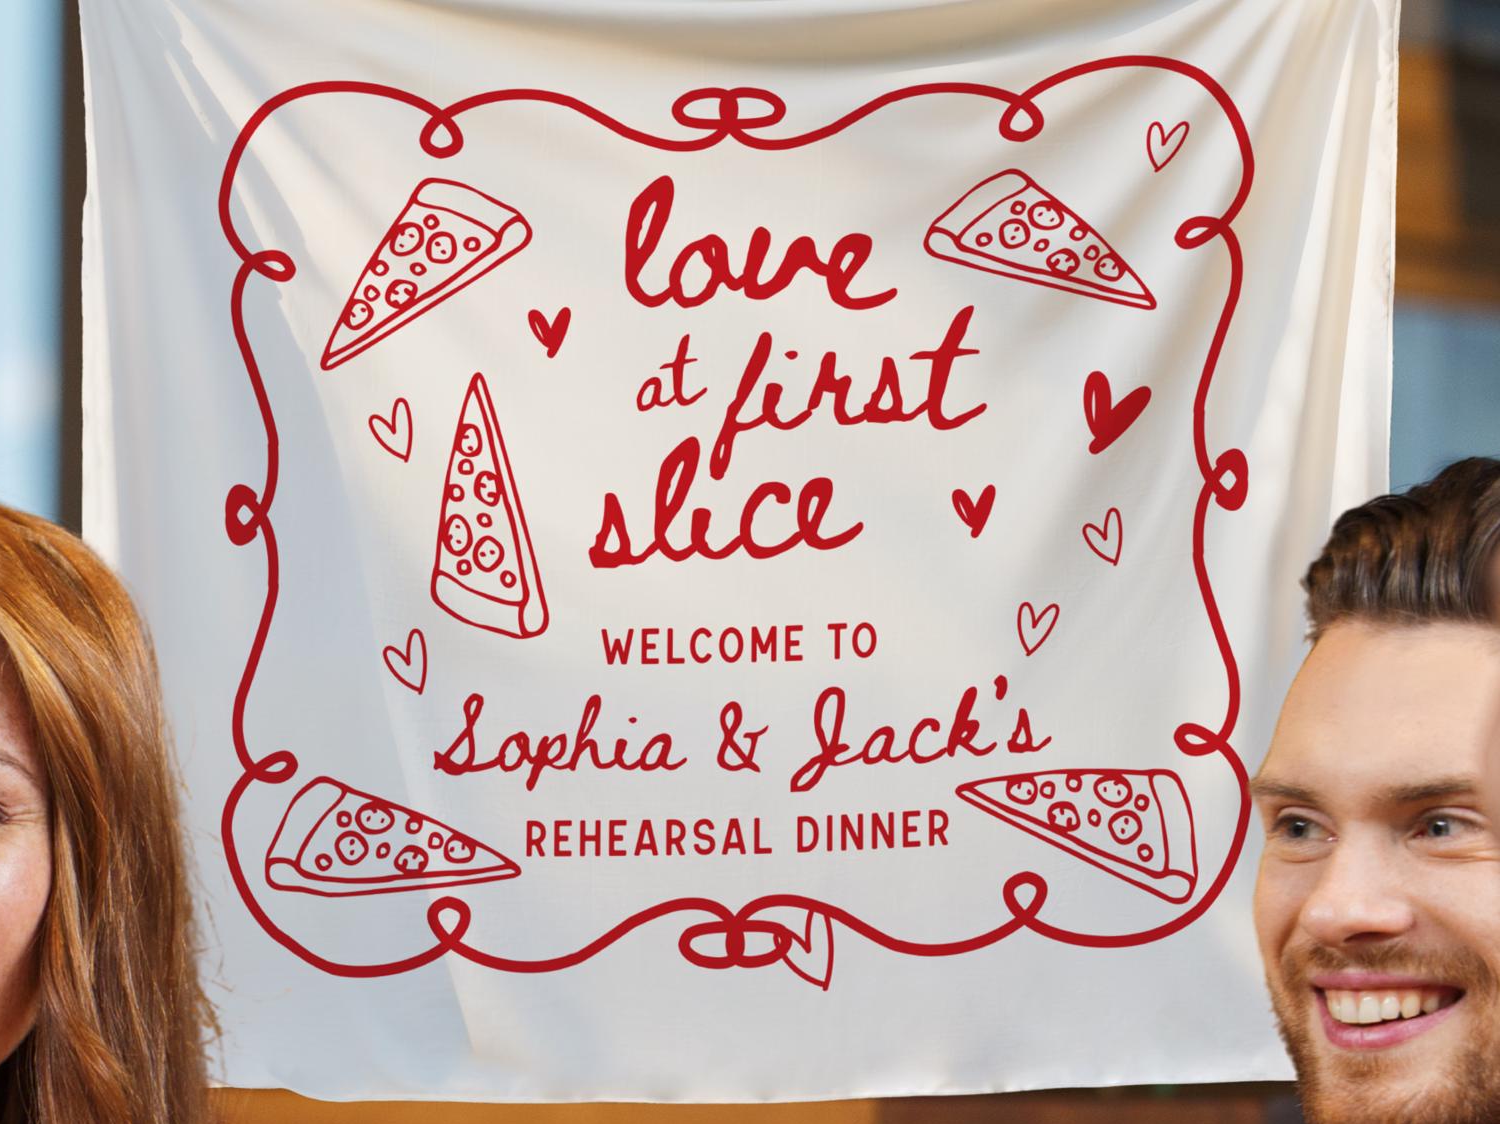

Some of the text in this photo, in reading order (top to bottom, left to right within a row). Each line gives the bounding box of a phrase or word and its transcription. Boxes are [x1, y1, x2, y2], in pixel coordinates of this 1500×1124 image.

[624, 175, 899, 311] love
[635, 304, 988, 481] at first
[587, 435, 865, 569] slice
[600, 621, 878, 666] WELCOME TO
[433, 674, 1053, 793] Sophia & Jack's
[525, 808, 950, 858] REHEARSAL DINNER
